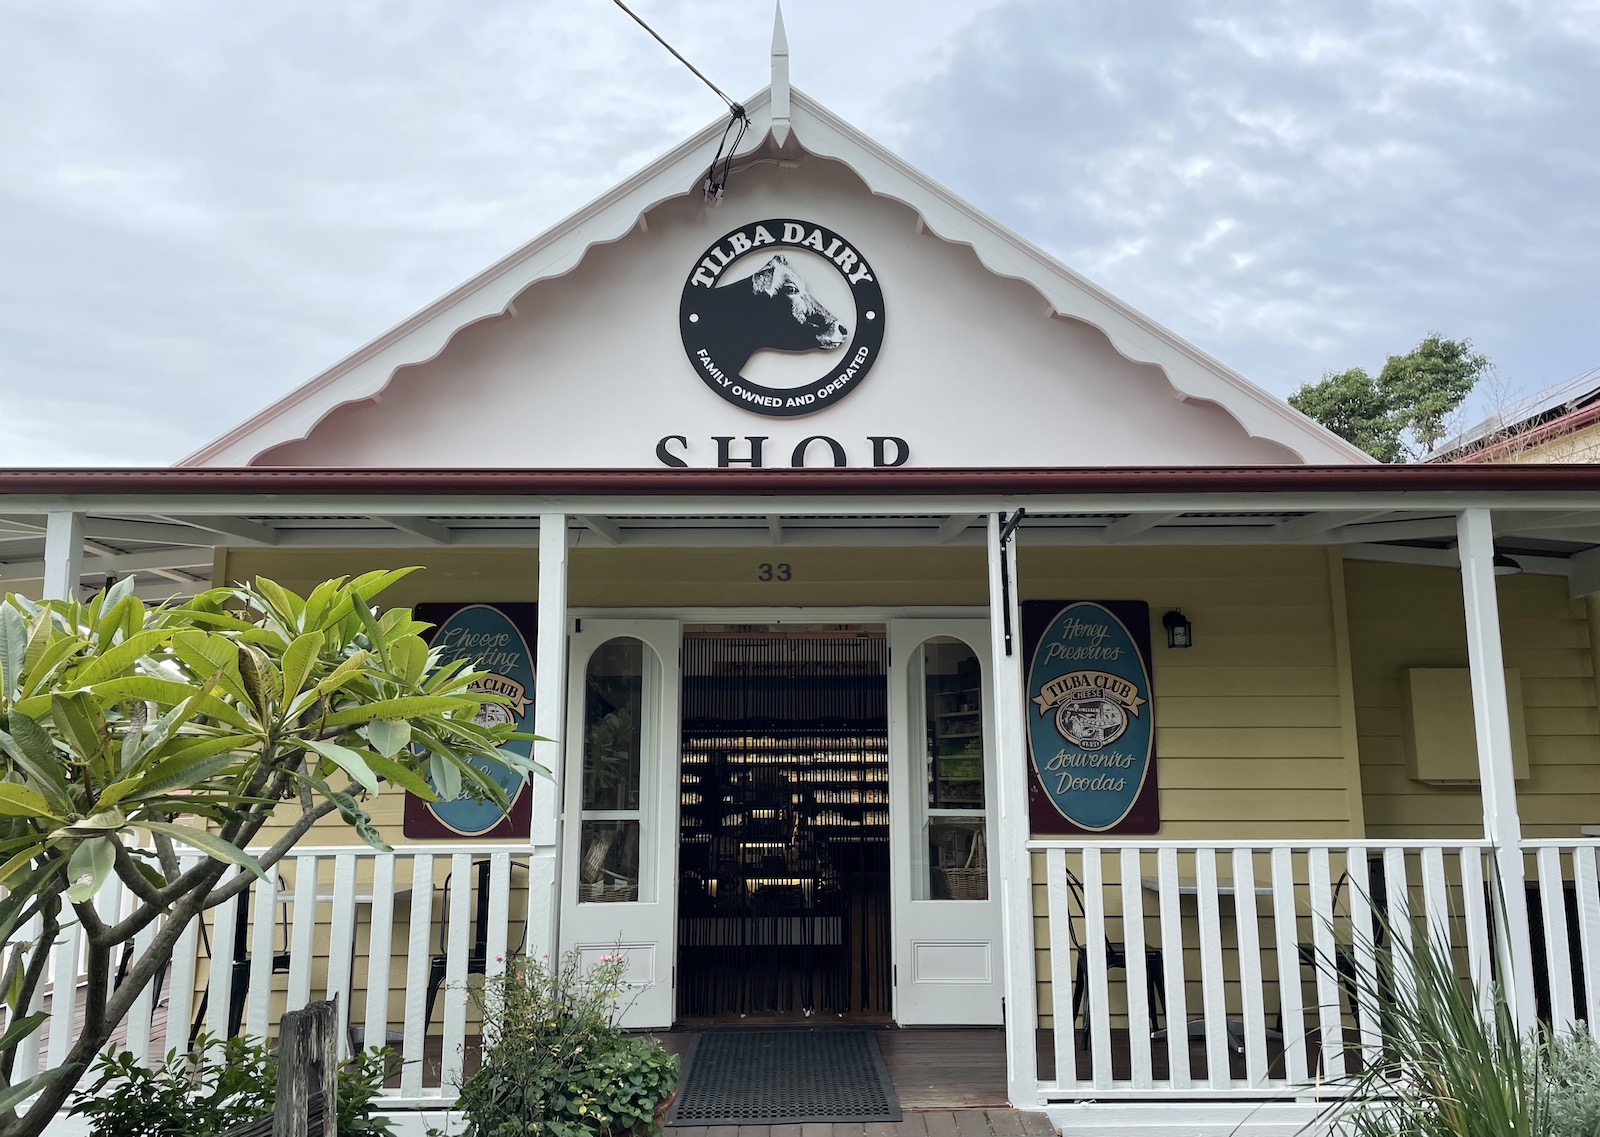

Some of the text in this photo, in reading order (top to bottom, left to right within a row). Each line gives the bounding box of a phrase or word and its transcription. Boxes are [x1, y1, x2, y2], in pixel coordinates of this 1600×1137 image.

[691, 222, 873, 289] TILBA DAIRY
[696, 346, 870, 408] FAMILY OWNED AND OPERATED
[655, 435, 910, 468] SHOP
[758, 563, 792, 581] 33
[443, 627, 511, 648] Cheese
[1062, 617, 1110, 647] Honey
[1044, 642, 1125, 666] Preserves
[483, 678, 519, 699] CLUB
[1046, 673, 1133, 699] TILBA CLUB
[1072, 688, 1102, 700] CHEESE
[1044, 748, 1136, 771] Souvenirs
[1055, 771, 1127, 796] Doodas
